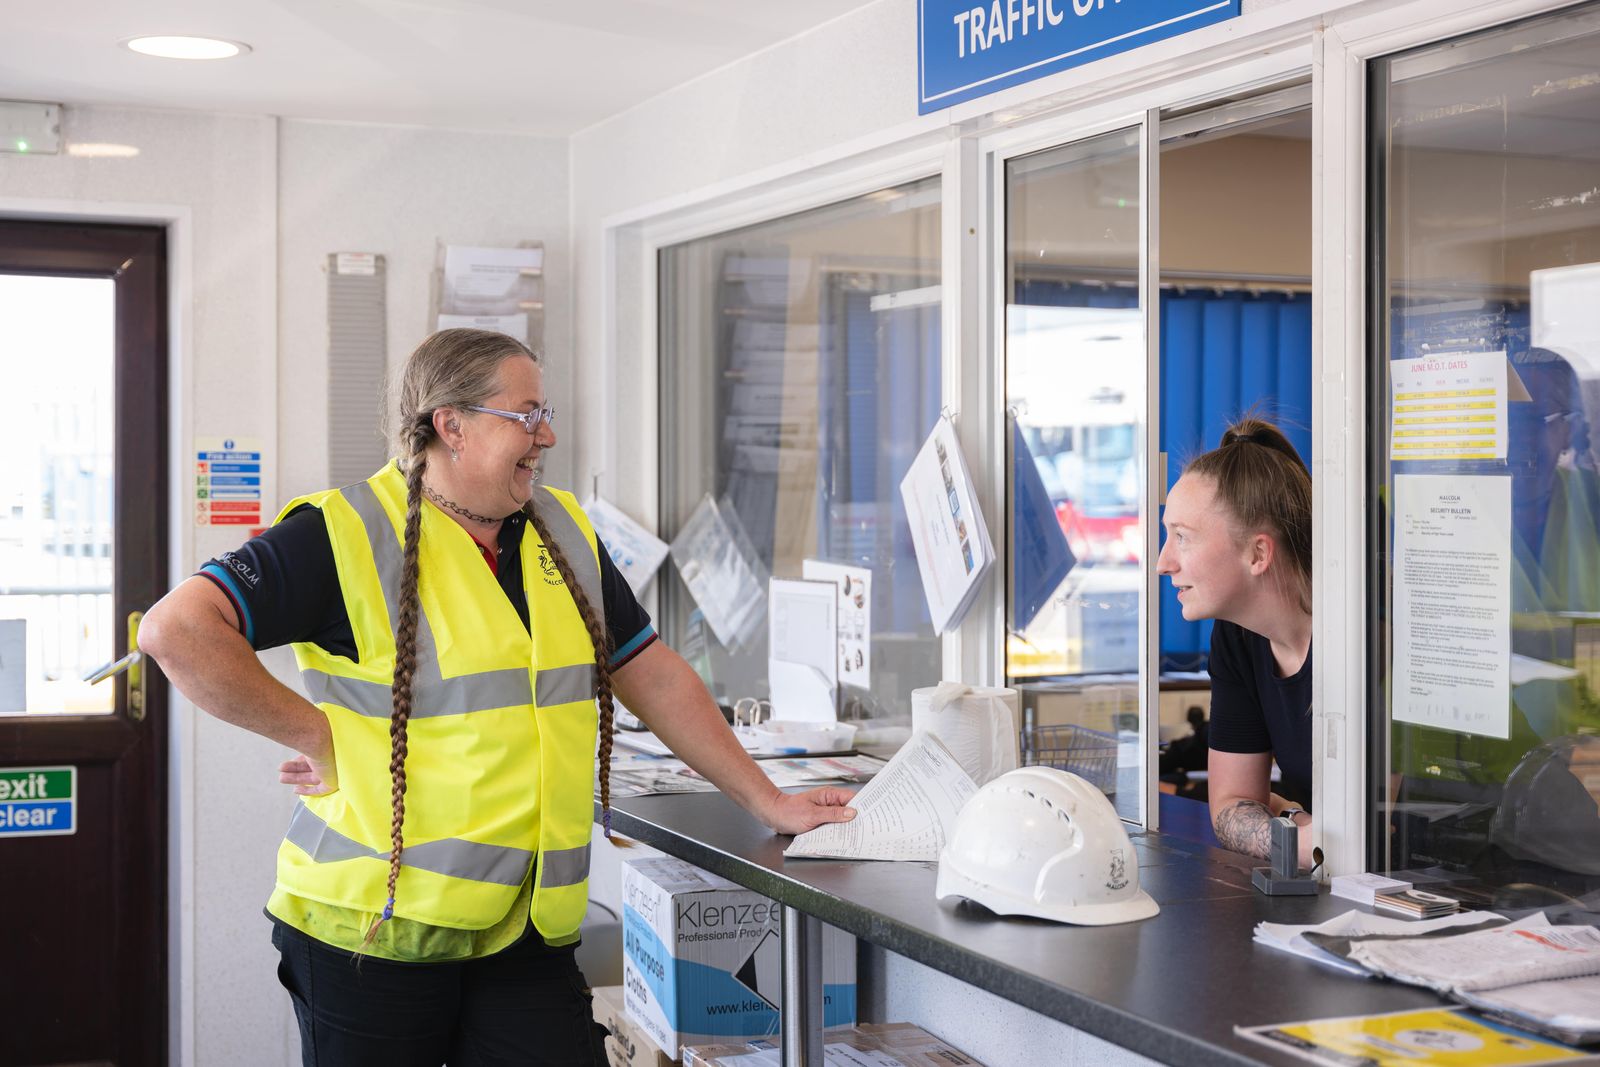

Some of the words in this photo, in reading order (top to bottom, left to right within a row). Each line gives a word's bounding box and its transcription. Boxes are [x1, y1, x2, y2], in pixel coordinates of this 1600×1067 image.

[953, 0, 1064, 58] TRAFFIC
[1411, 363, 1426, 373] JUNE
[1448, 360, 1468, 370] DATES
[0, 773, 48, 799] exit
[678, 901, 779, 929] Klenzee
[678, 930, 737, 943] Professional
[635, 937, 665, 982] Purpose
[626, 966, 647, 1005] Cloths
